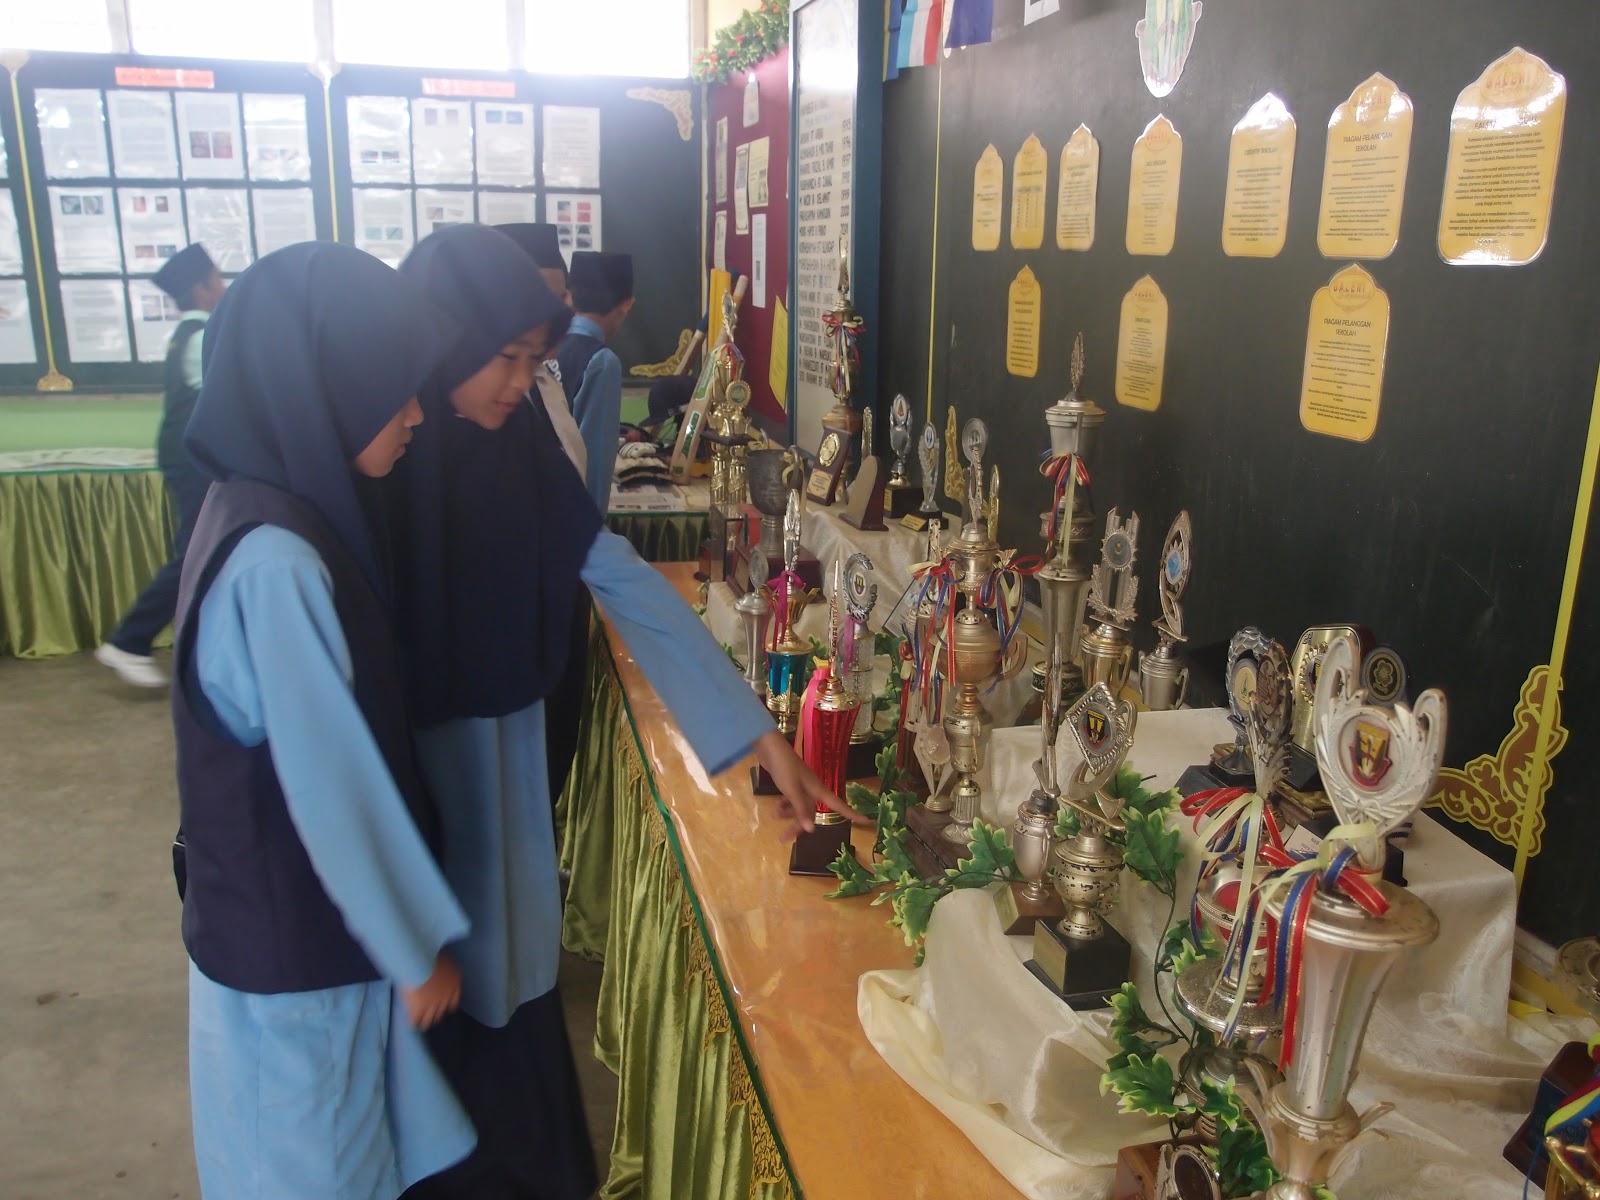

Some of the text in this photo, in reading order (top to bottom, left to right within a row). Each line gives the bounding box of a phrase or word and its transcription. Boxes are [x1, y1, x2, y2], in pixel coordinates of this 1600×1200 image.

[1343, 132, 1392, 143] PIAGAM PELANGGAN
[1355, 144, 1377, 152] SEKOLAH
[1323, 318, 1372, 328] PIAGAM PELANGGAN
[1335, 328, 1357, 337] SEKOLAH
